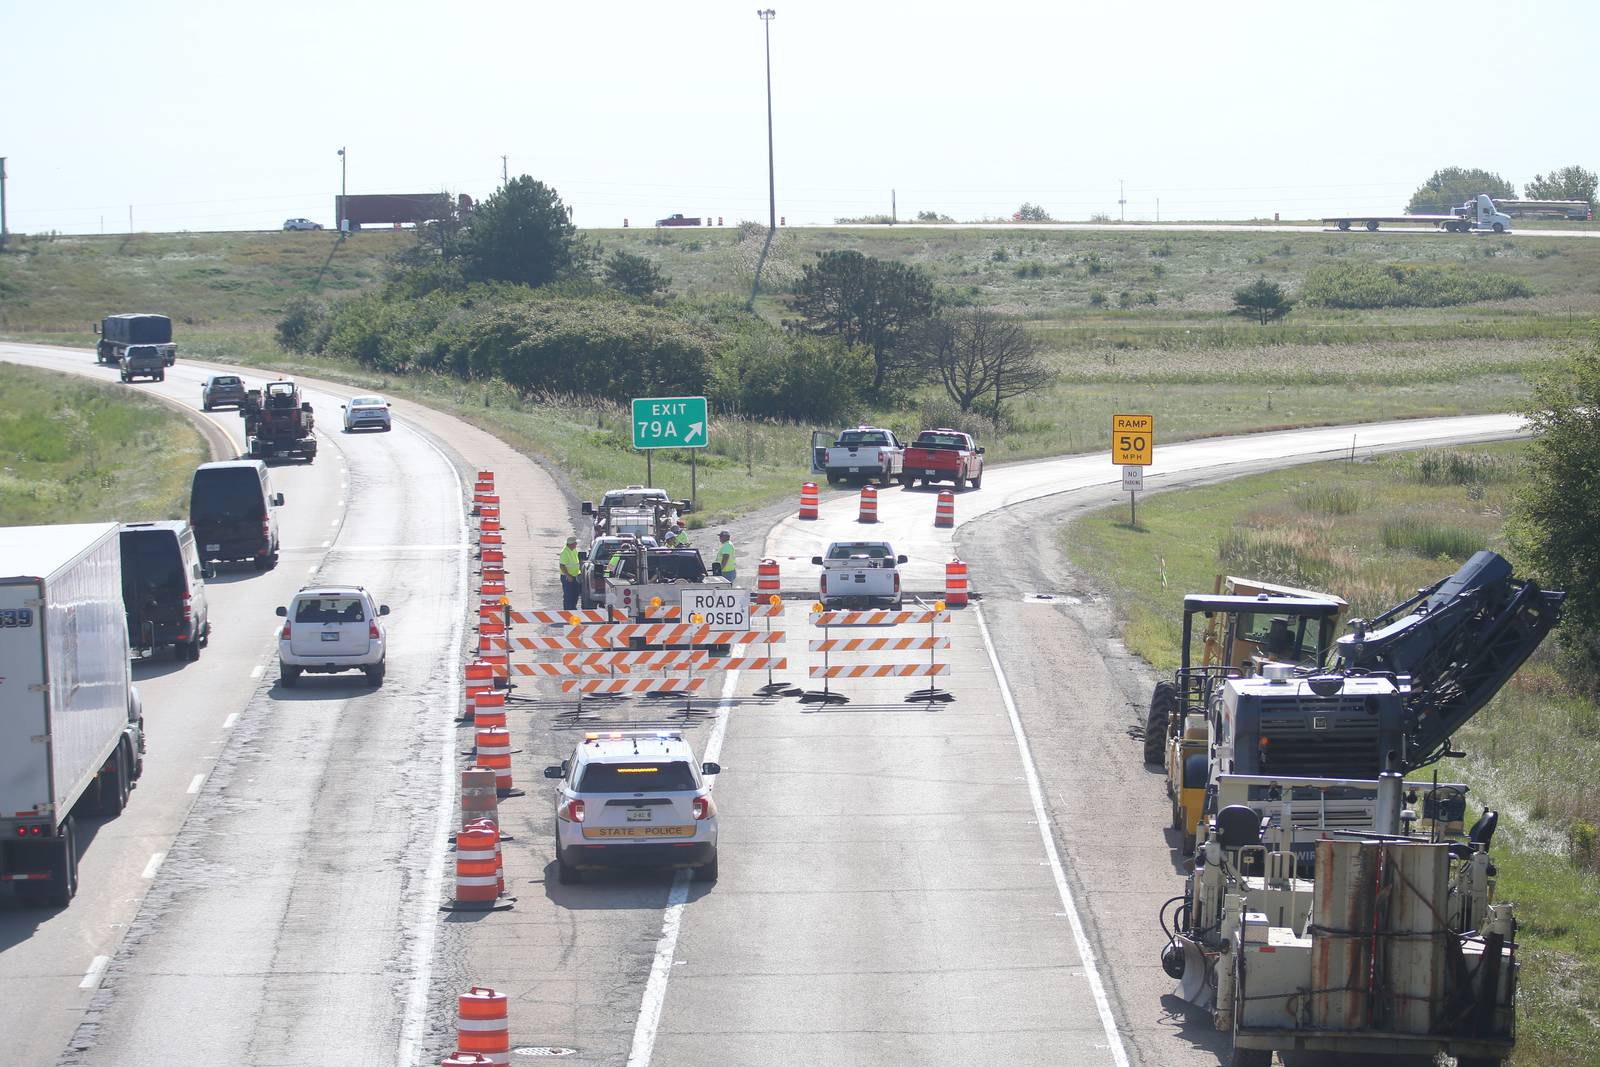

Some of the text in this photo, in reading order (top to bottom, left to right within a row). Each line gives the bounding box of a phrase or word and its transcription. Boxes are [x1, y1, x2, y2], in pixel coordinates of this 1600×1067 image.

[652, 403, 687, 416] EXIT
[638, 421, 678, 438] 79A
[1118, 419, 1148, 428] RAMP
[1120, 436, 1146, 451] 50
[695, 595, 736, 608] ROAD
[688, 612, 744, 625] COSED
[600, 826, 683, 836] STATE POLICE
